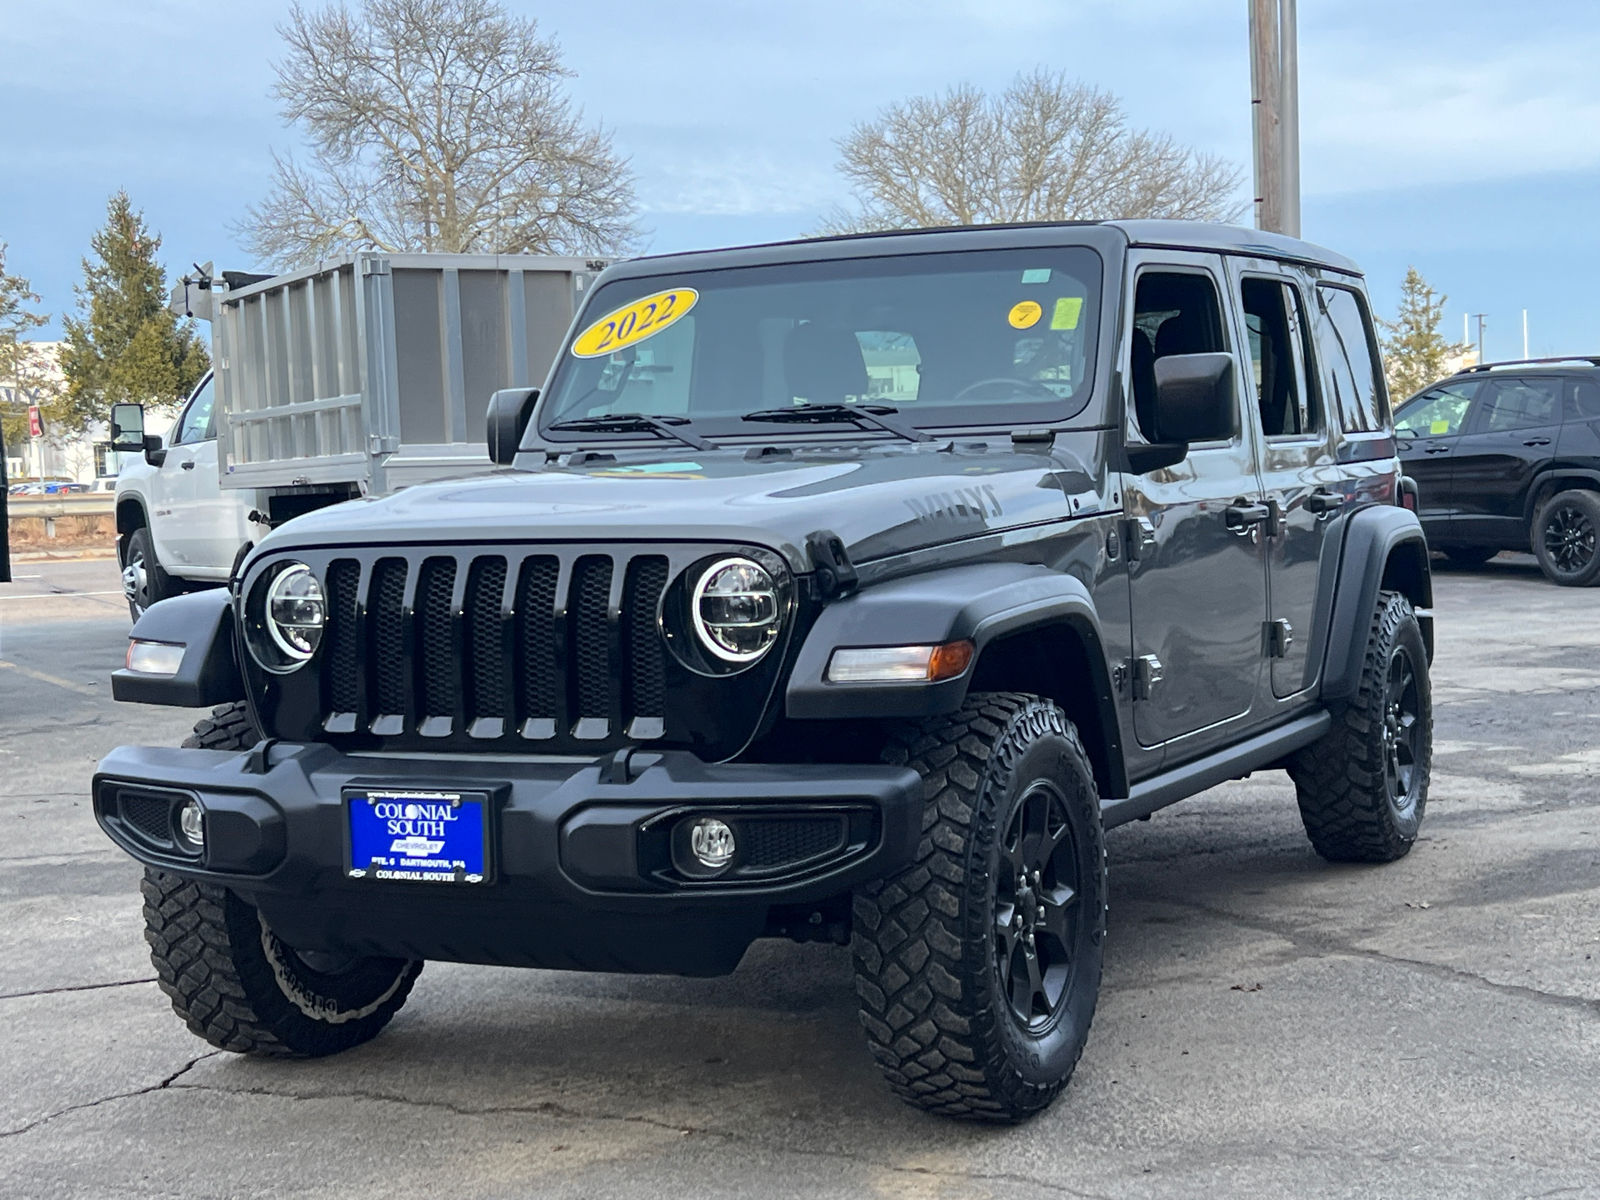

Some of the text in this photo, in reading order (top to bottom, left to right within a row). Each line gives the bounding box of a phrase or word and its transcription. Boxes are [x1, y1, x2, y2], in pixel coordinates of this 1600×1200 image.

[595, 294, 677, 351] 2022
[902, 484, 1003, 523] WILLYS
[374, 802, 459, 821] COLONIAL
[387, 819, 446, 837] SOUTH
[395, 841, 439, 850] CHEVROLET
[389, 858, 396, 866] 6
[376, 869, 455, 882] COLONIAL SOUTH
